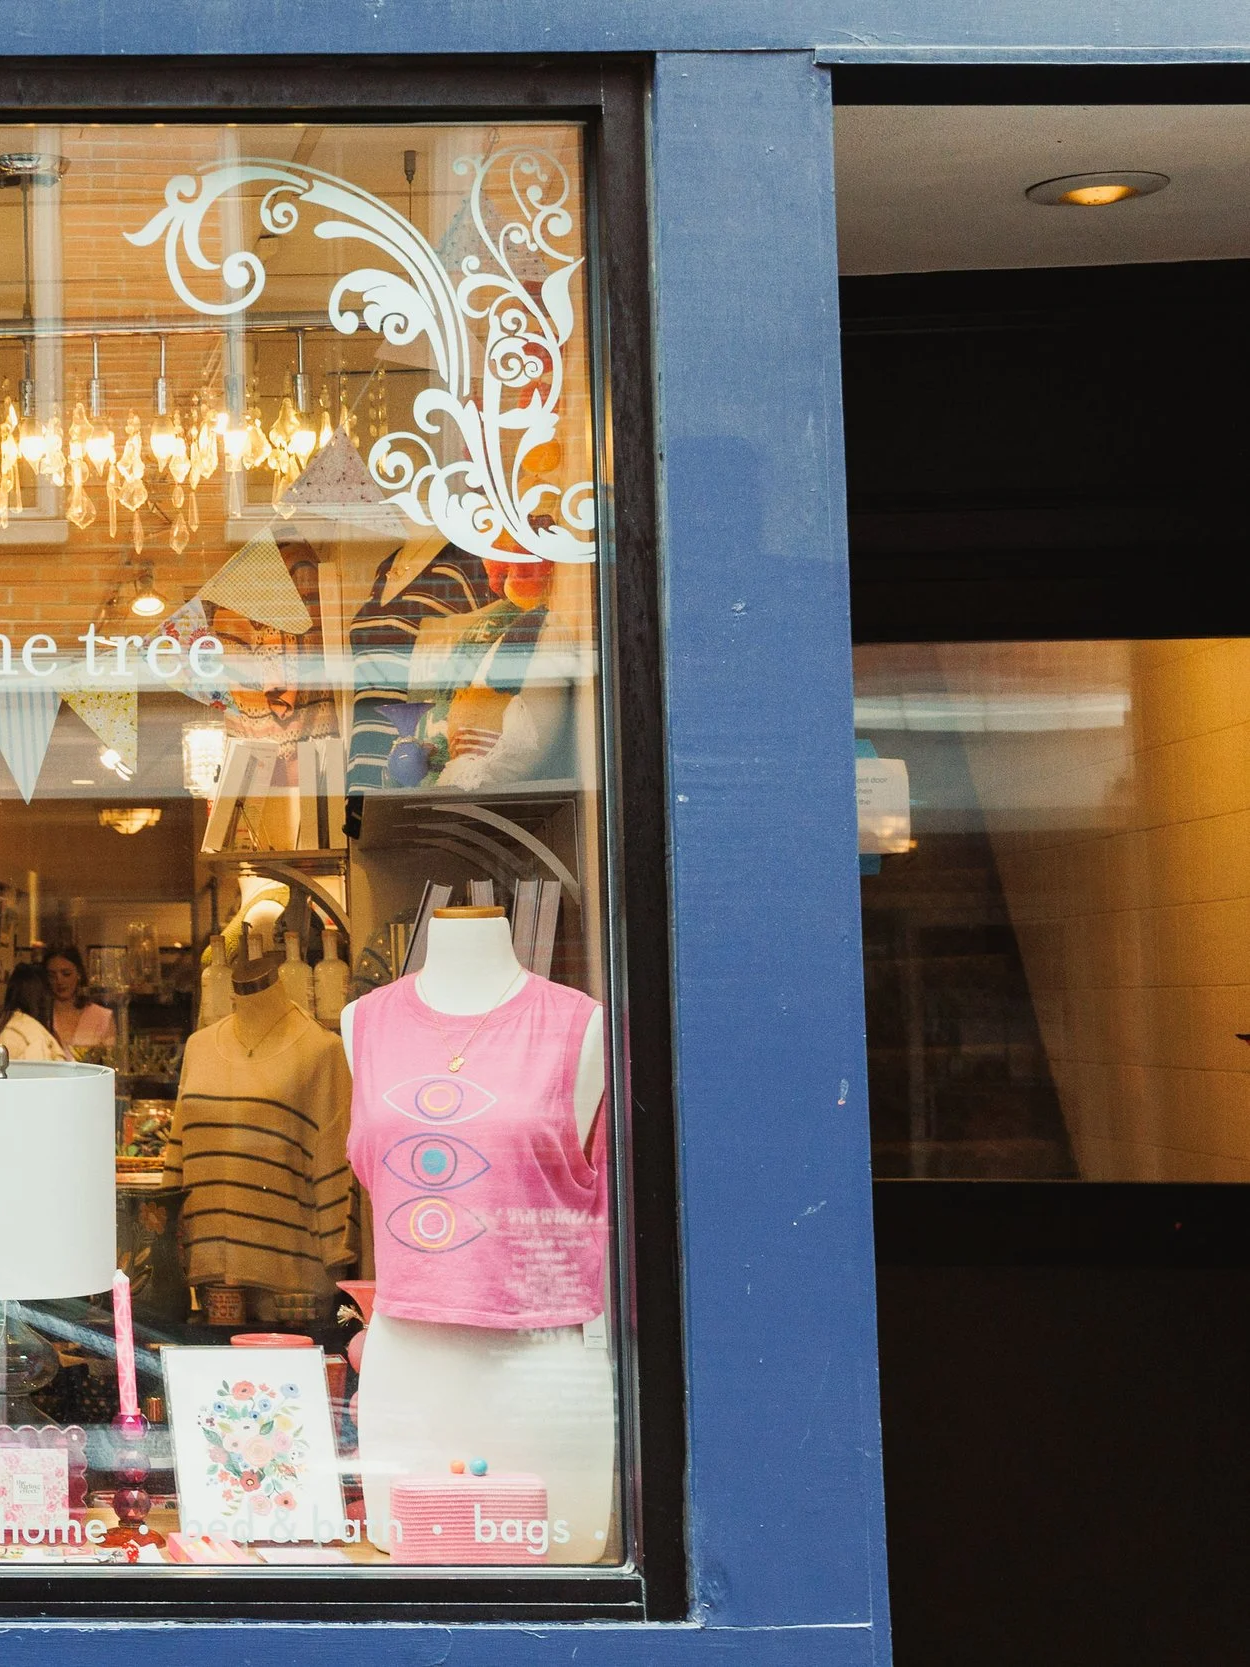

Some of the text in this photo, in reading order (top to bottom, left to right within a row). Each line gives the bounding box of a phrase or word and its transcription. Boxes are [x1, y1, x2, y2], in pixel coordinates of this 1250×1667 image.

[77, 622, 225, 678] tree
[181, 1504, 254, 1543] bed
[269, 1505, 299, 1543] &
[312, 1503, 404, 1543] bath
[474, 1503, 572, 1554] bags
